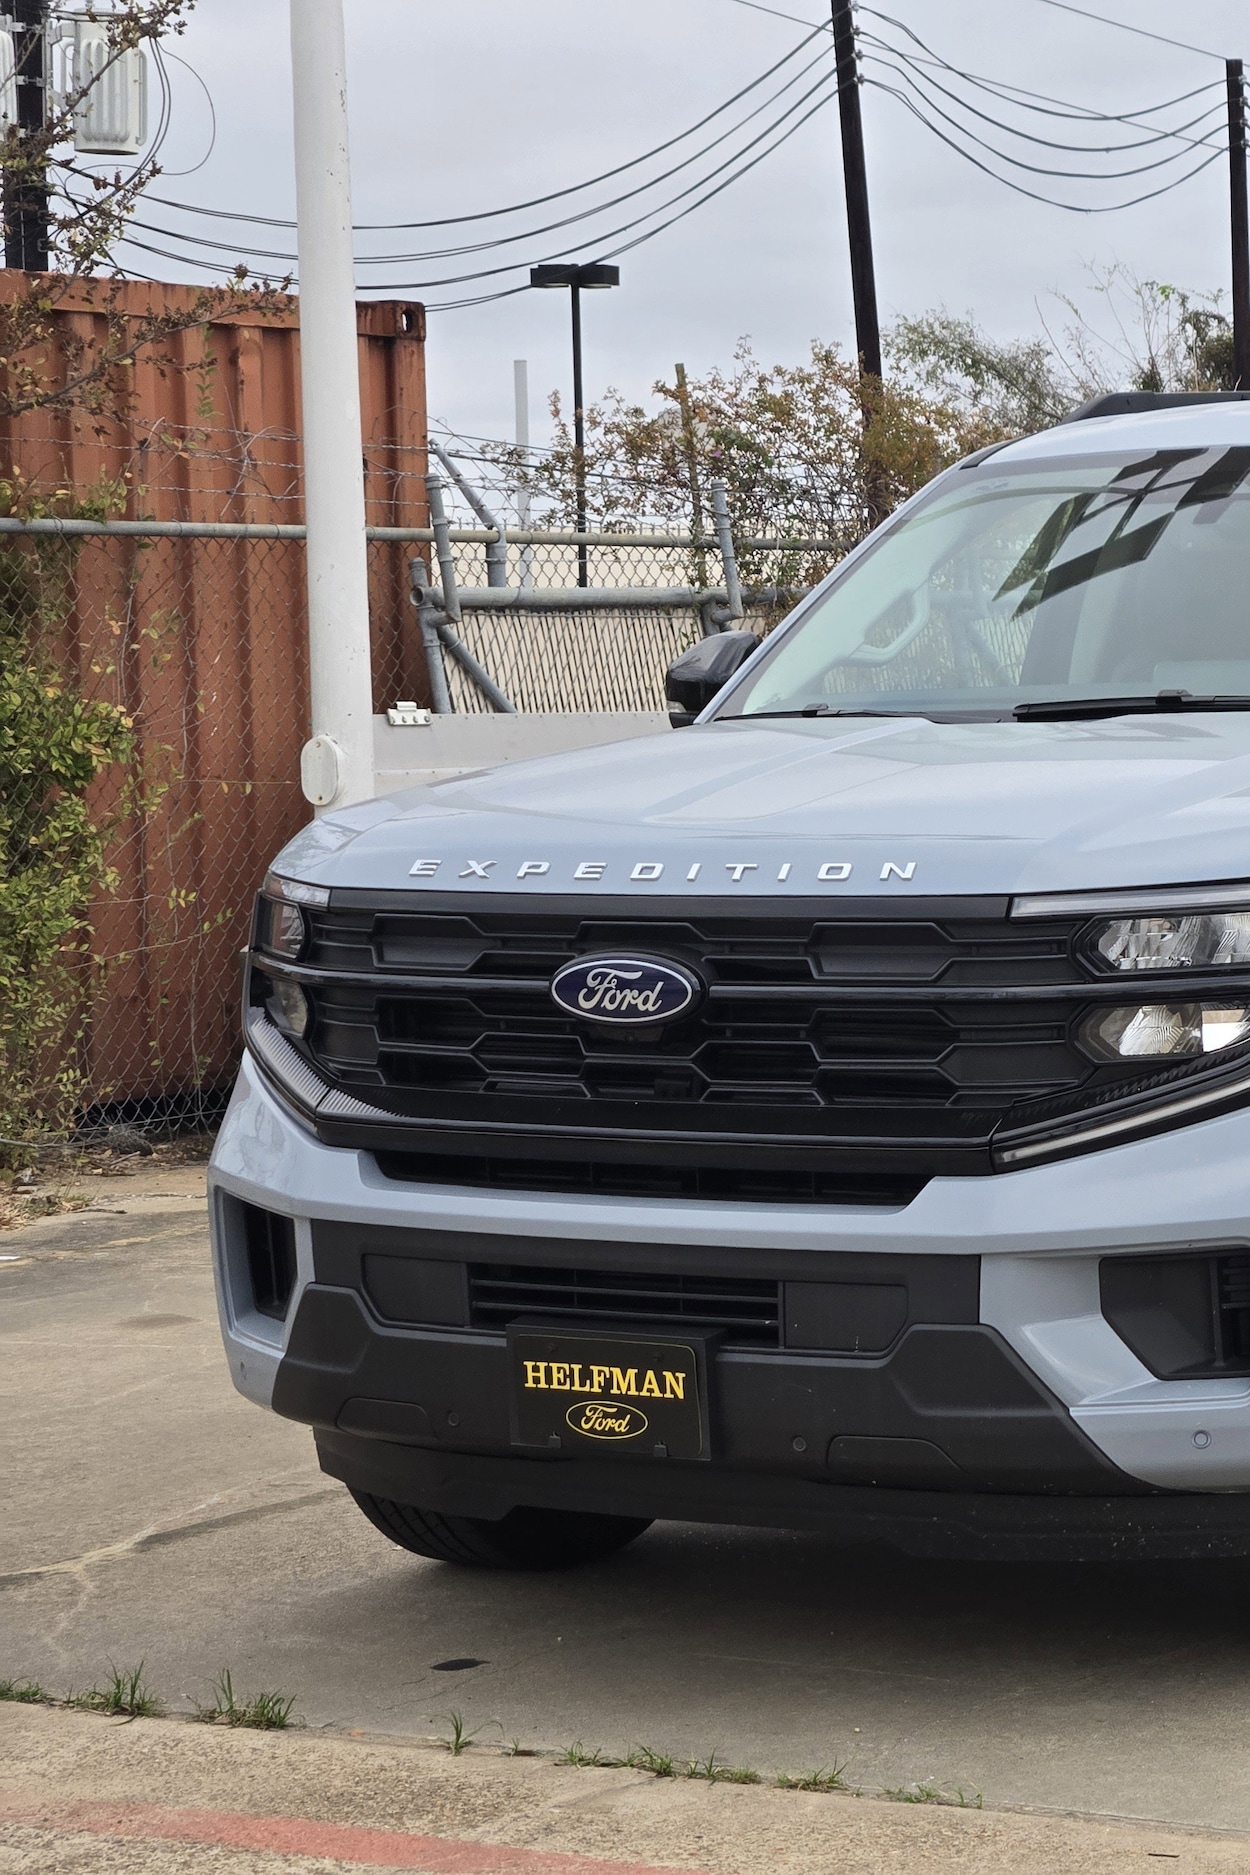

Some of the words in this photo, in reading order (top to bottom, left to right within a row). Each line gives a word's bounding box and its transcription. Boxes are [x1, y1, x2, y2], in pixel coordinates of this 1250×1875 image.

[408, 859, 917, 882] EXPEDITION
[578, 967, 664, 1012] Ford
[523, 1361, 686, 1399] HELFMAN
[580, 1404, 631, 1433] Ford
